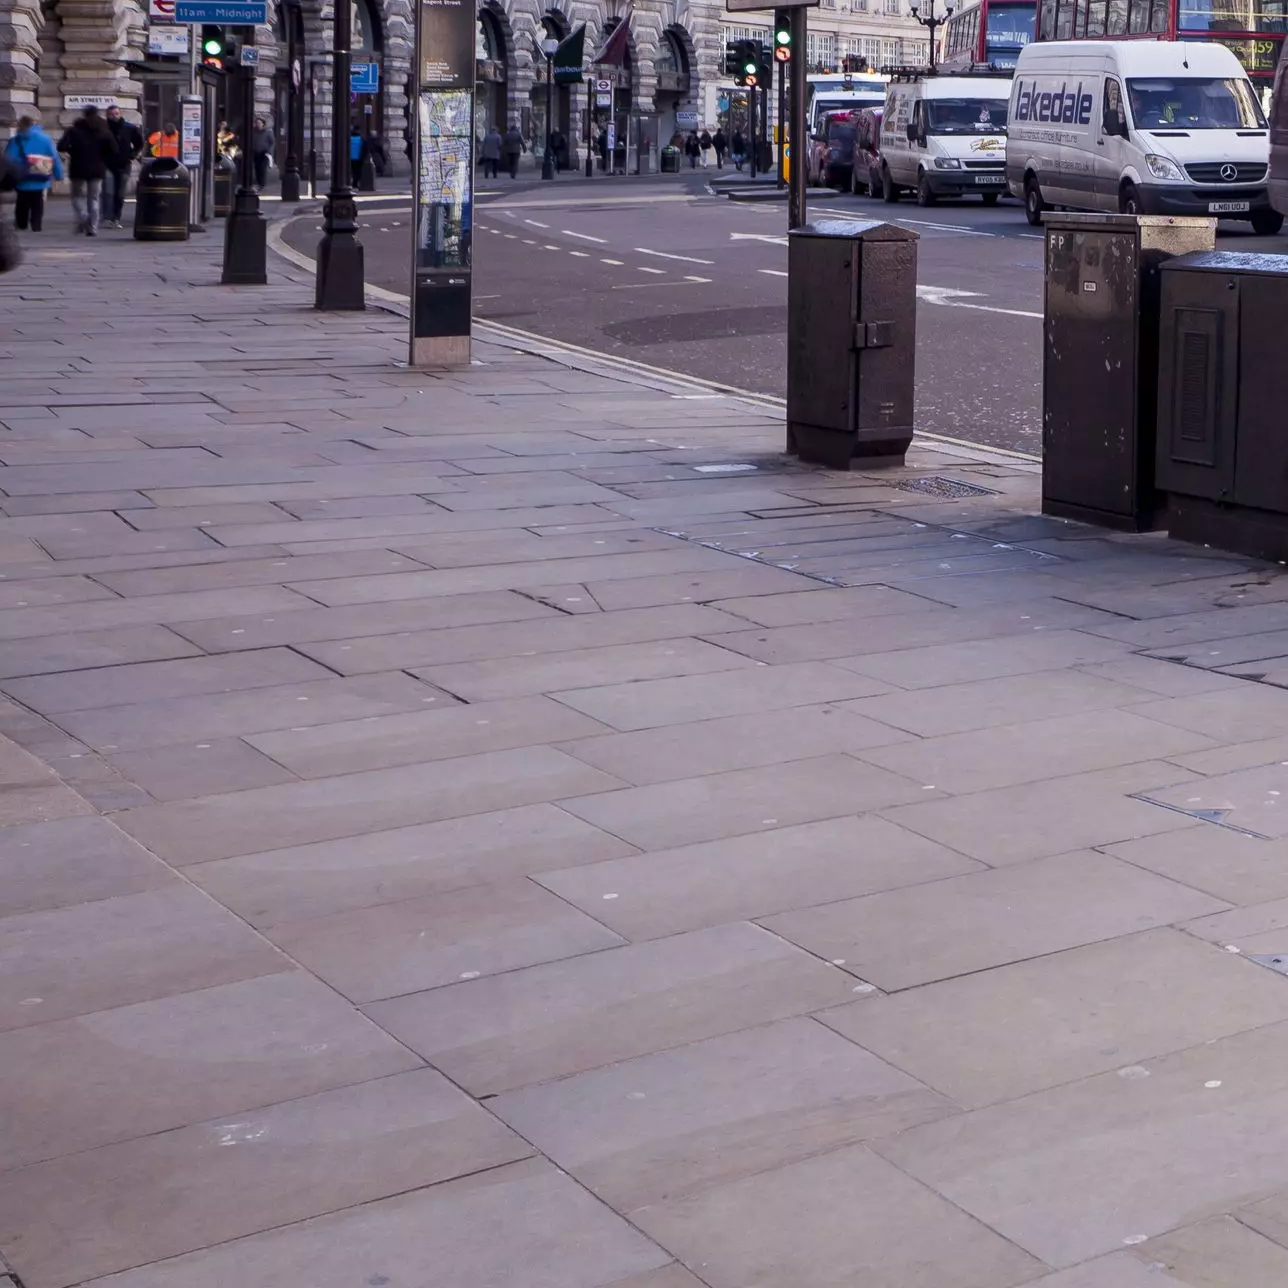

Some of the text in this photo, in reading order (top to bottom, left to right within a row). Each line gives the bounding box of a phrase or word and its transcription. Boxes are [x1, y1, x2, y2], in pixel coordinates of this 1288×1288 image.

[215, 8, 263, 19] Midnight
[1254, 40, 1274, 54] 159
[1015, 81, 1093, 125] lakedale
